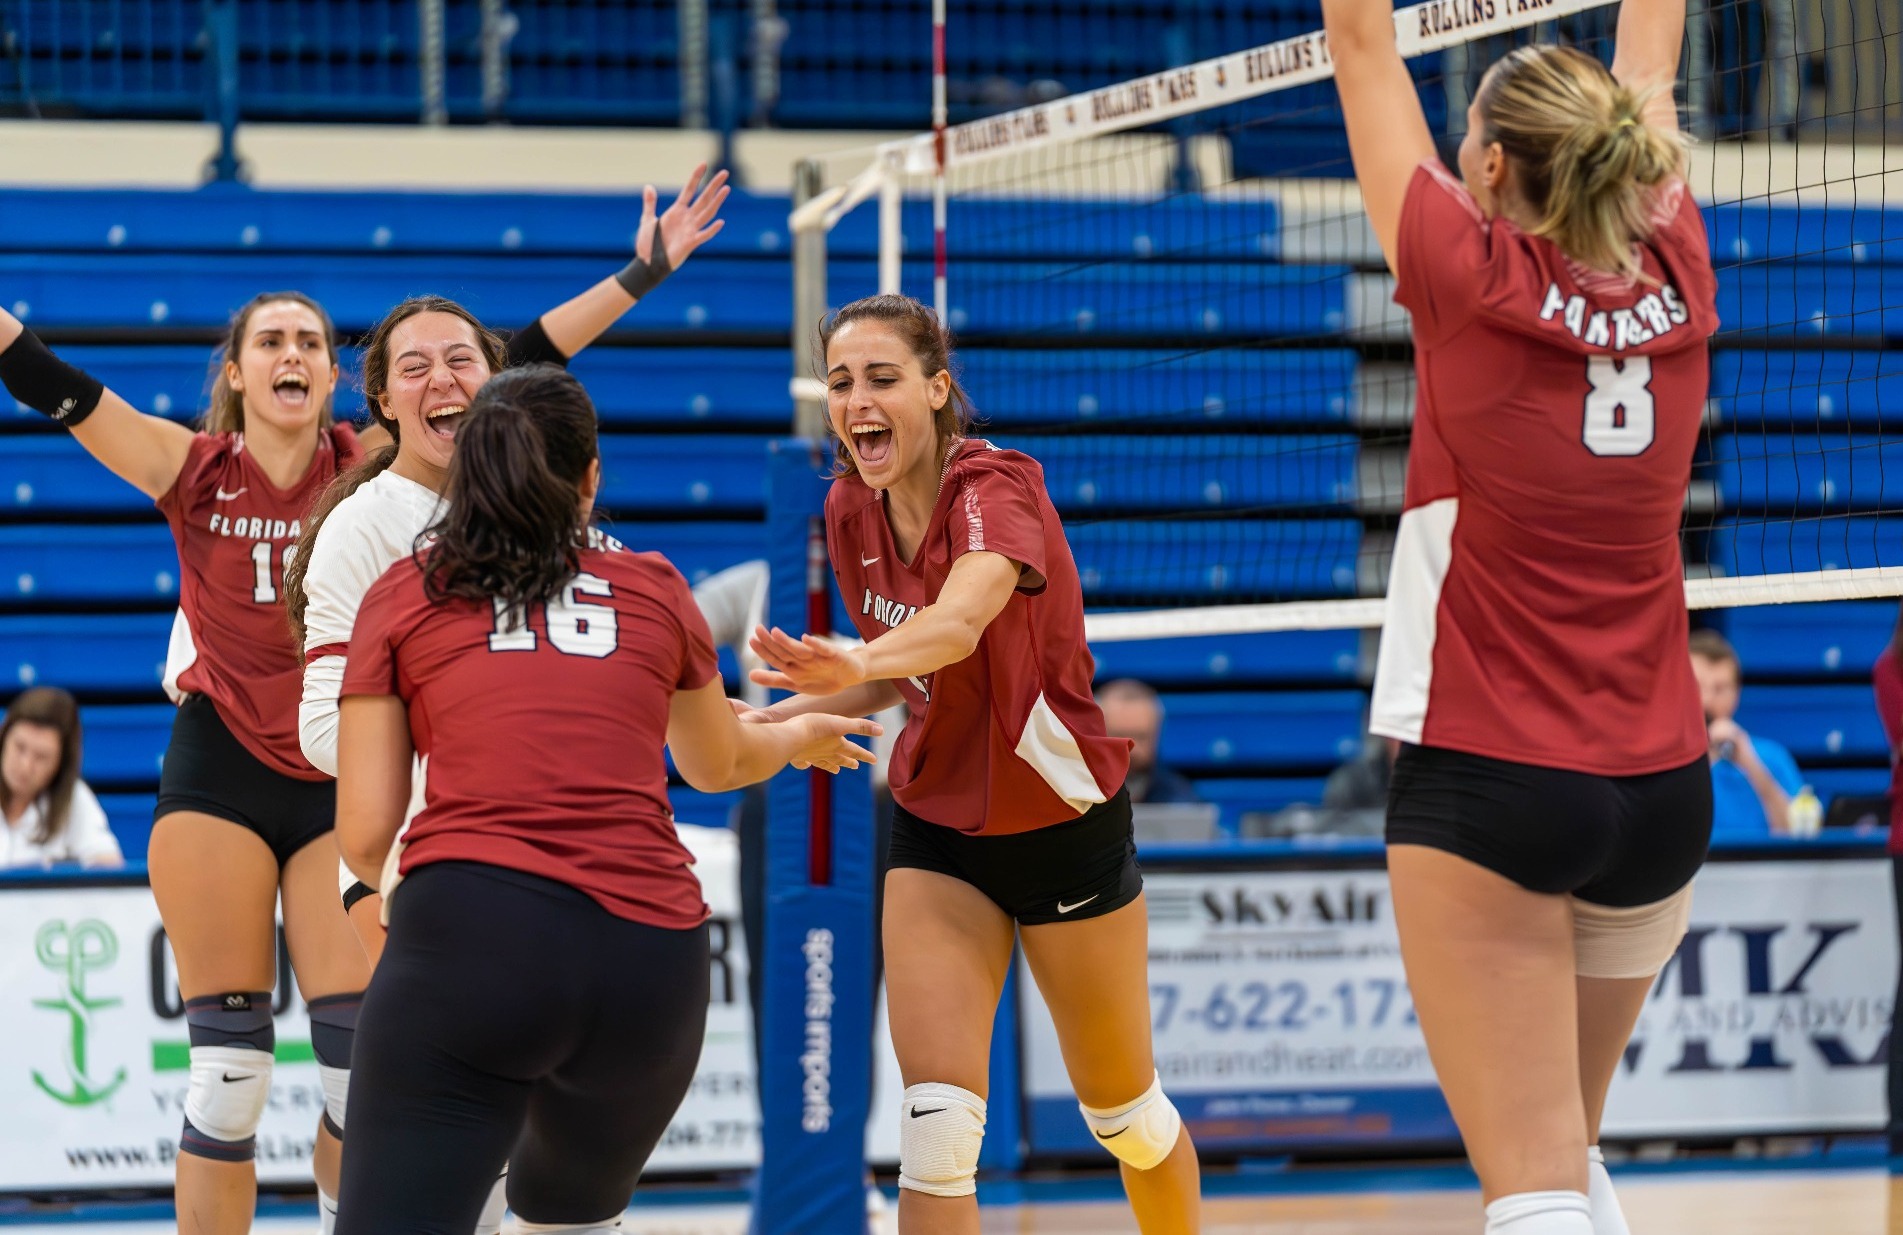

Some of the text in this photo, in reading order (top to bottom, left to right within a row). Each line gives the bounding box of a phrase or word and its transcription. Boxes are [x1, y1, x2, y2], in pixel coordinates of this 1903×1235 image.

[1419, 0, 1496, 37] ROLLINS
[1582, 355, 1655, 457] 8
[208, 512, 301, 539] FLORIDA
[487, 571, 619, 659] 16
[861, 586, 918, 629] FORIDA
[1674, 1001, 1756, 1032] AND
